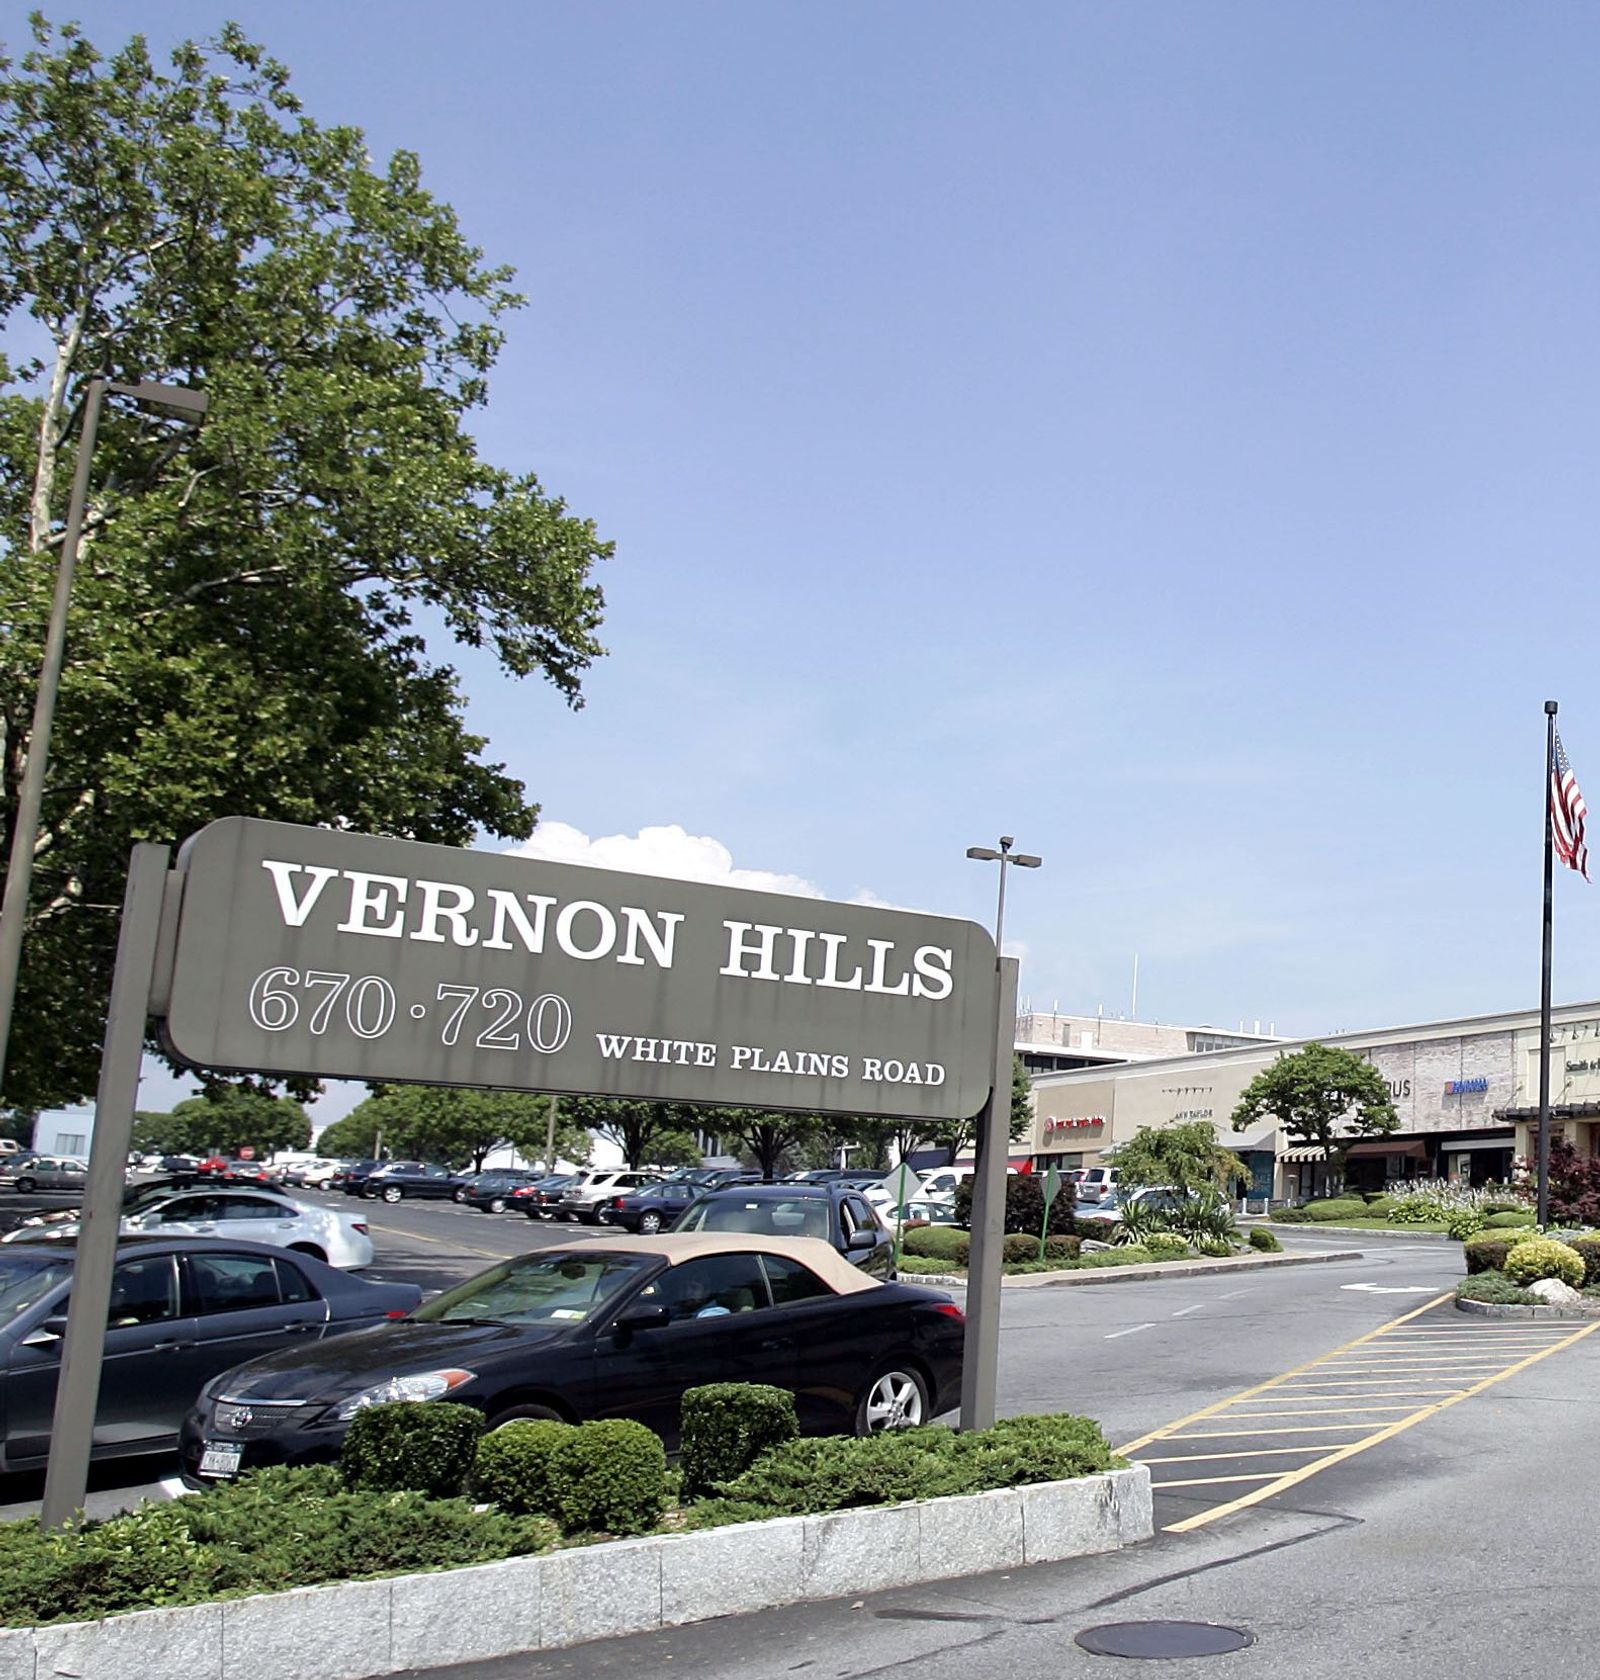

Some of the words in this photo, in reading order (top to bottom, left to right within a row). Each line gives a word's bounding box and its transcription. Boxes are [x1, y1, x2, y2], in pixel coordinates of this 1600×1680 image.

[261, 859, 685, 969] VERNON
[719, 920, 953, 1001] HILLS
[596, 1033, 717, 1068] WHITE
[730, 1045, 850, 1079] PLAINS
[861, 1058, 946, 1087] ROAD
